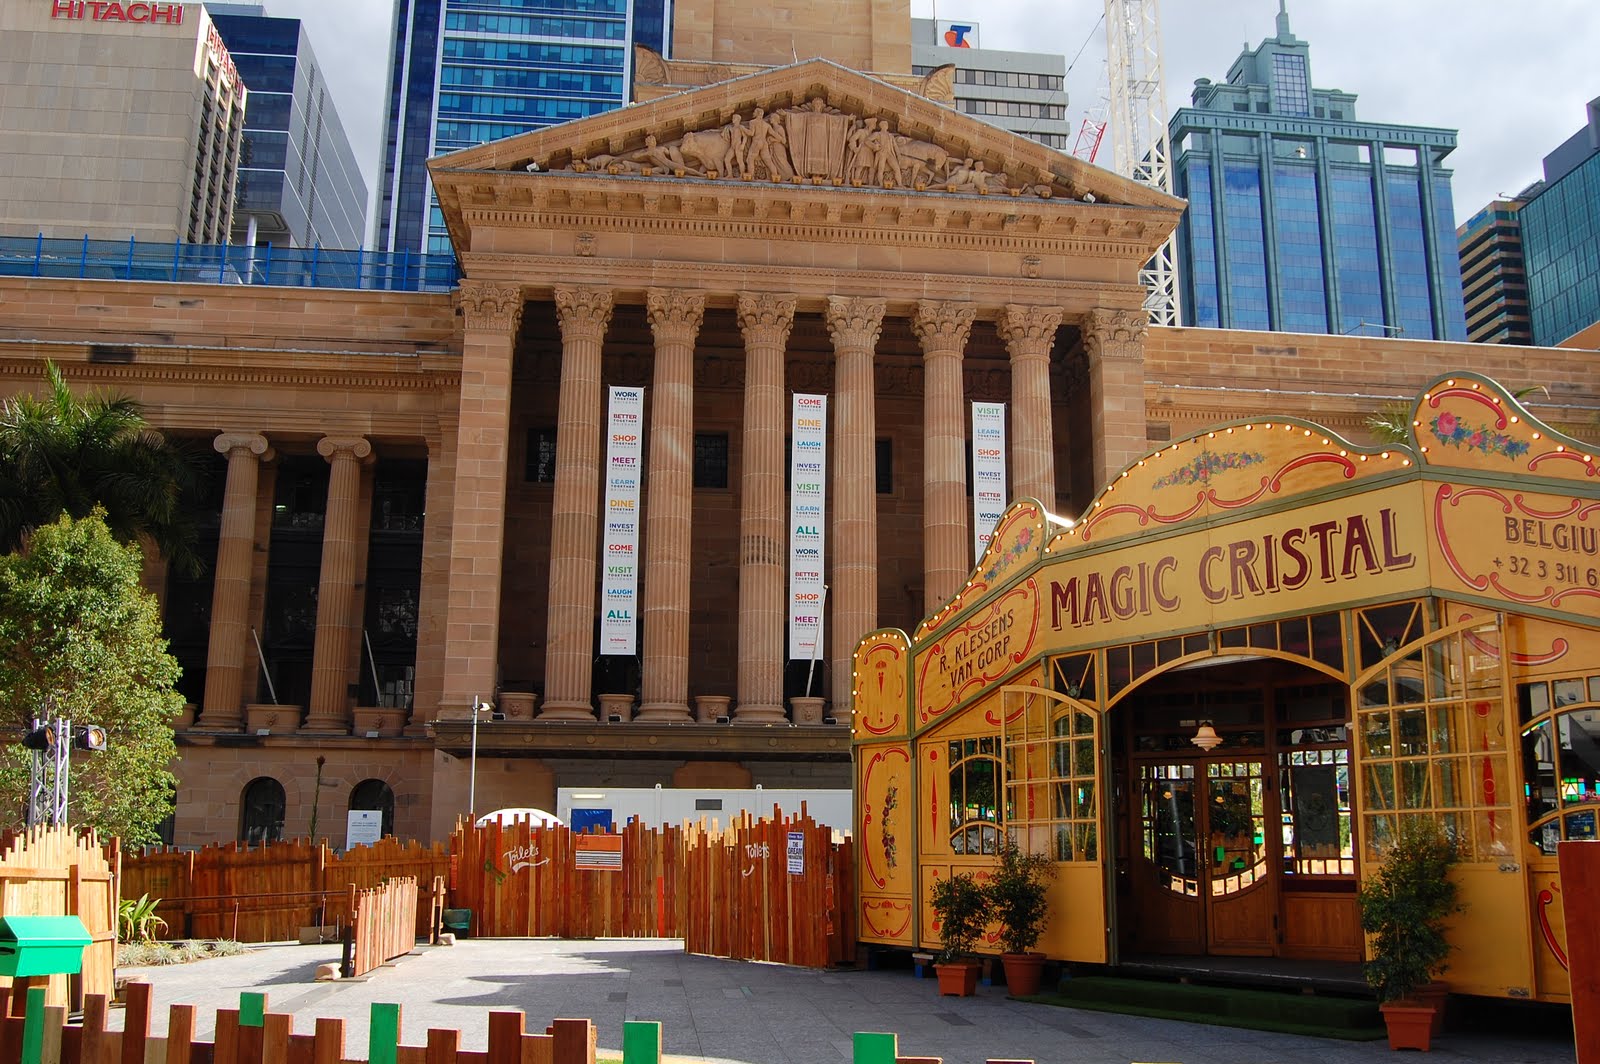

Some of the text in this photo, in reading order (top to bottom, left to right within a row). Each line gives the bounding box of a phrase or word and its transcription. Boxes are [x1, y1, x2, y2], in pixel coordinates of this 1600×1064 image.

[51, 0, 184, 25] HITACHI
[796, 526, 819, 534] ALL
[1505, 516, 1600, 556] BELGIU
[1050, 508, 1416, 631] MAGIC CRISTAL
[1509, 555, 1531, 577] 32
[1537, 560, 1548, 578] 3
[1555, 563, 1580, 585] 311
[1586, 568, 1600, 587] 6
[607, 610, 631, 619] ALL
[940, 609, 1014, 674] R. KLESSENS
[950, 660, 972, 688] VAN
[978, 635, 1010, 669] GORP
[503, 844, 539, 868] Toilets
[745, 841, 769, 859] Toilets
